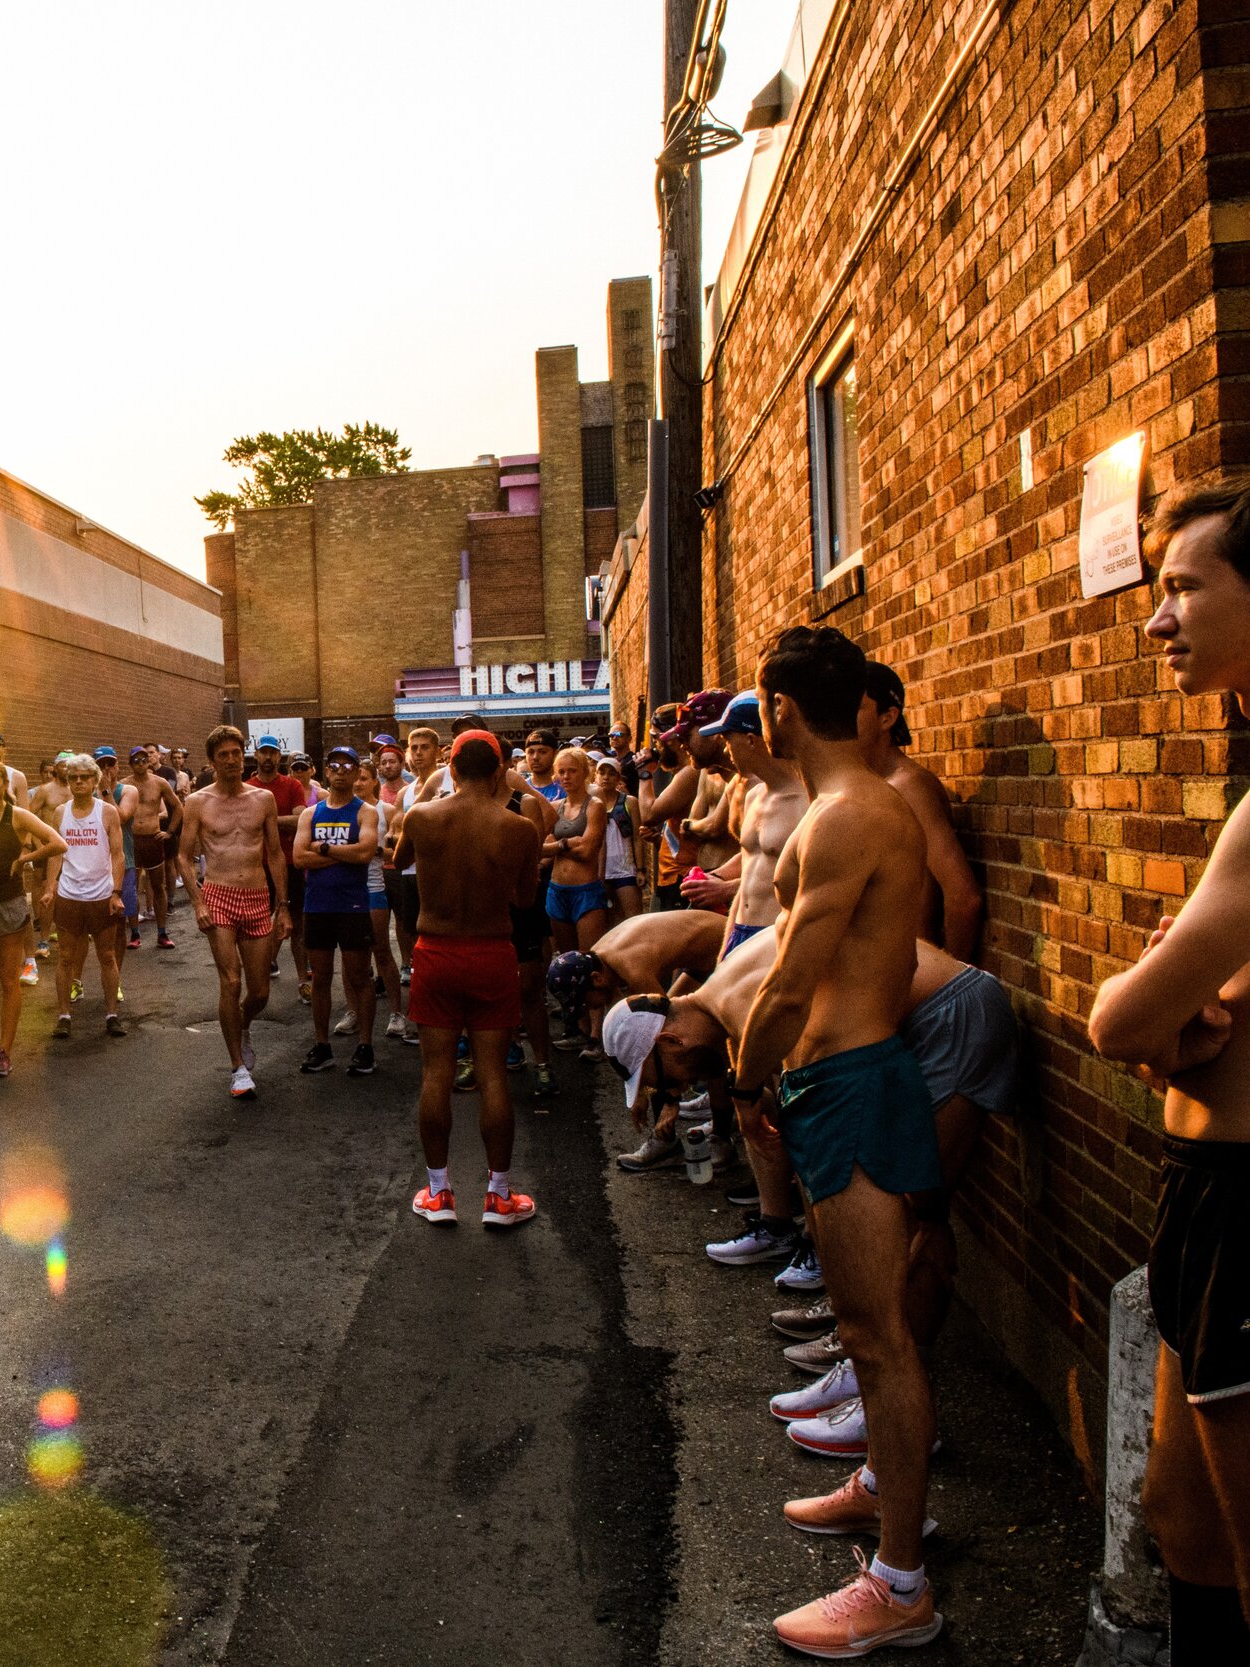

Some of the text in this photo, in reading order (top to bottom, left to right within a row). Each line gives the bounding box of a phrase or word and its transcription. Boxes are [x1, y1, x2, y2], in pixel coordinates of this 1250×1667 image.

[523, 718, 564, 728] COMING
[569, 717, 598, 726] SOON
[66, 828, 98, 837] MILL CITY
[315, 827, 350, 839] RUN
[65, 838, 98, 846] RUNNING
